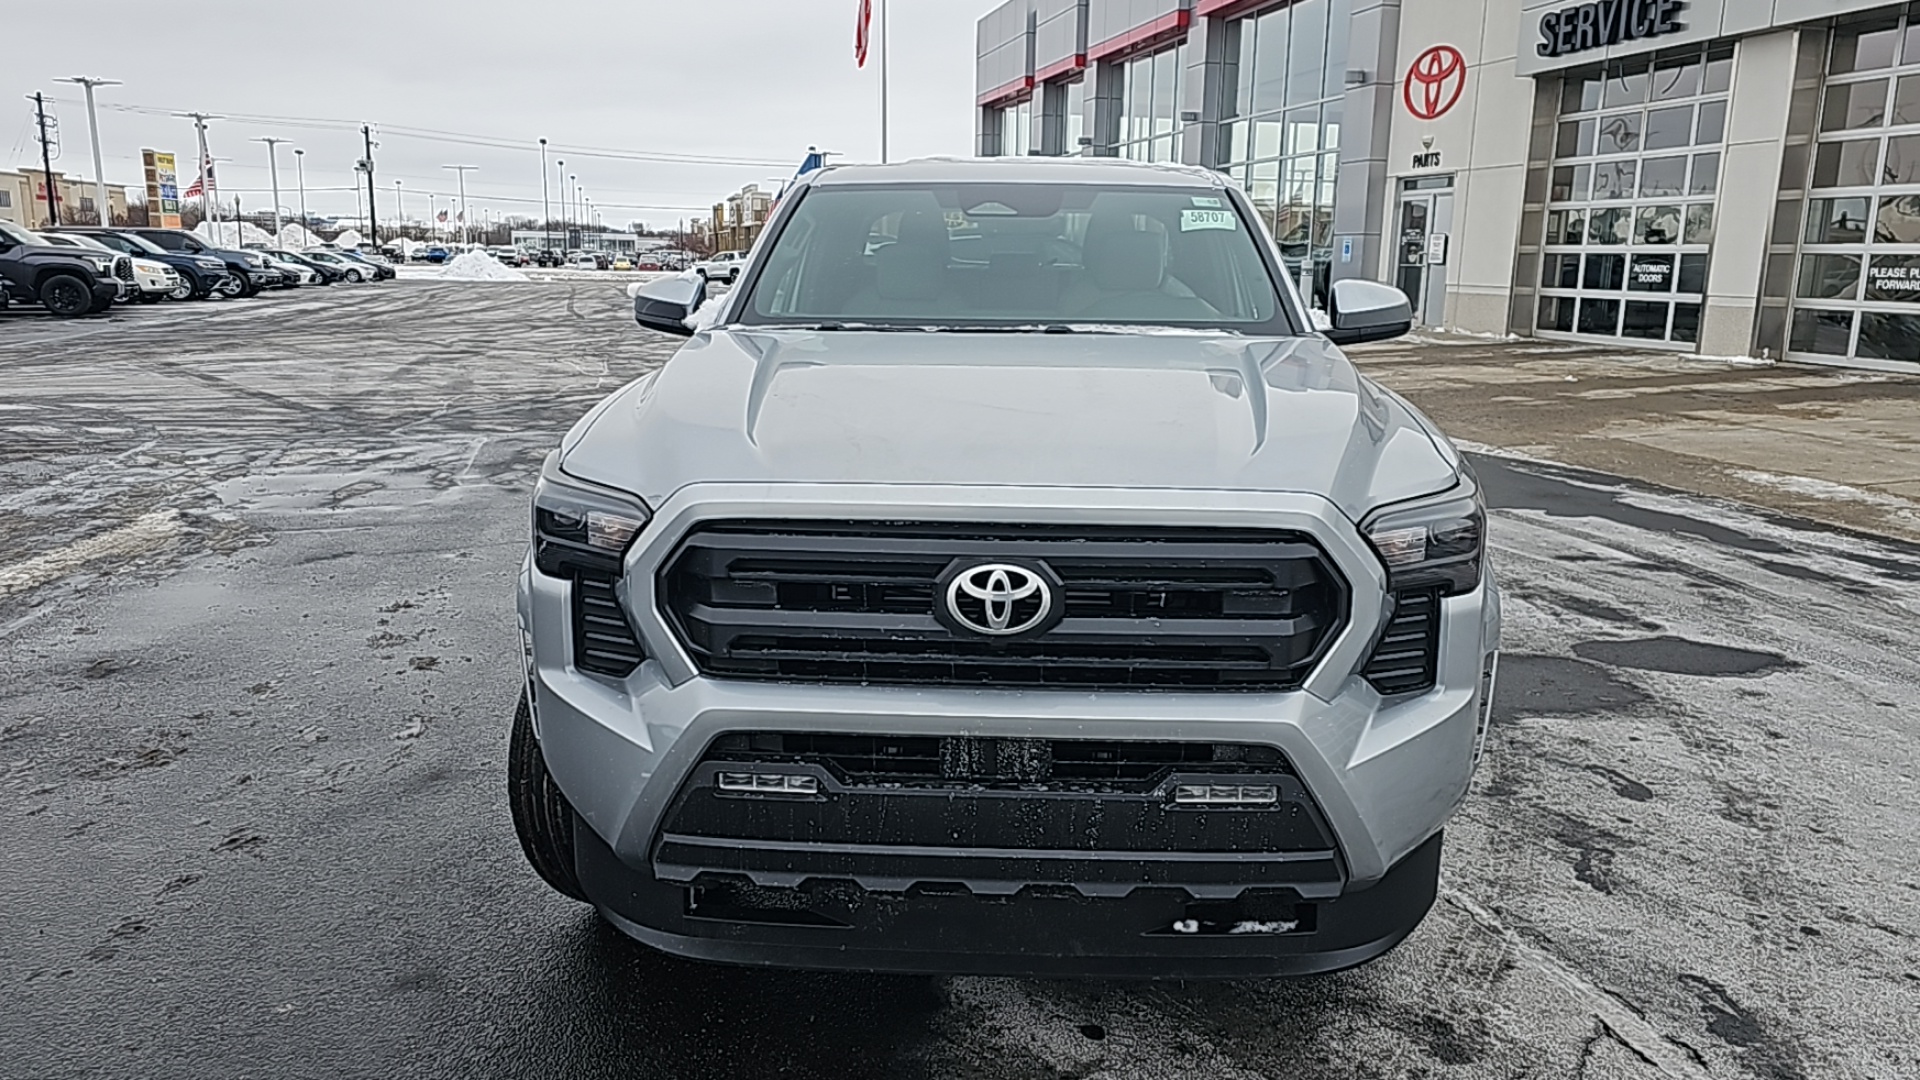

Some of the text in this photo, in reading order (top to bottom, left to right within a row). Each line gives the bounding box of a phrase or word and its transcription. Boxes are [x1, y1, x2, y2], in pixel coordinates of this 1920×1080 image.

[1537, 0, 1690, 57] SERVICE
[1412, 151, 1441, 169] PARTS
[1190, 211, 1225, 223] 58707
[1632, 264, 1670, 274] AUTOMATIC
[1870, 267, 1907, 278] PLEASE
[1638, 273, 1663, 283] DOORS
